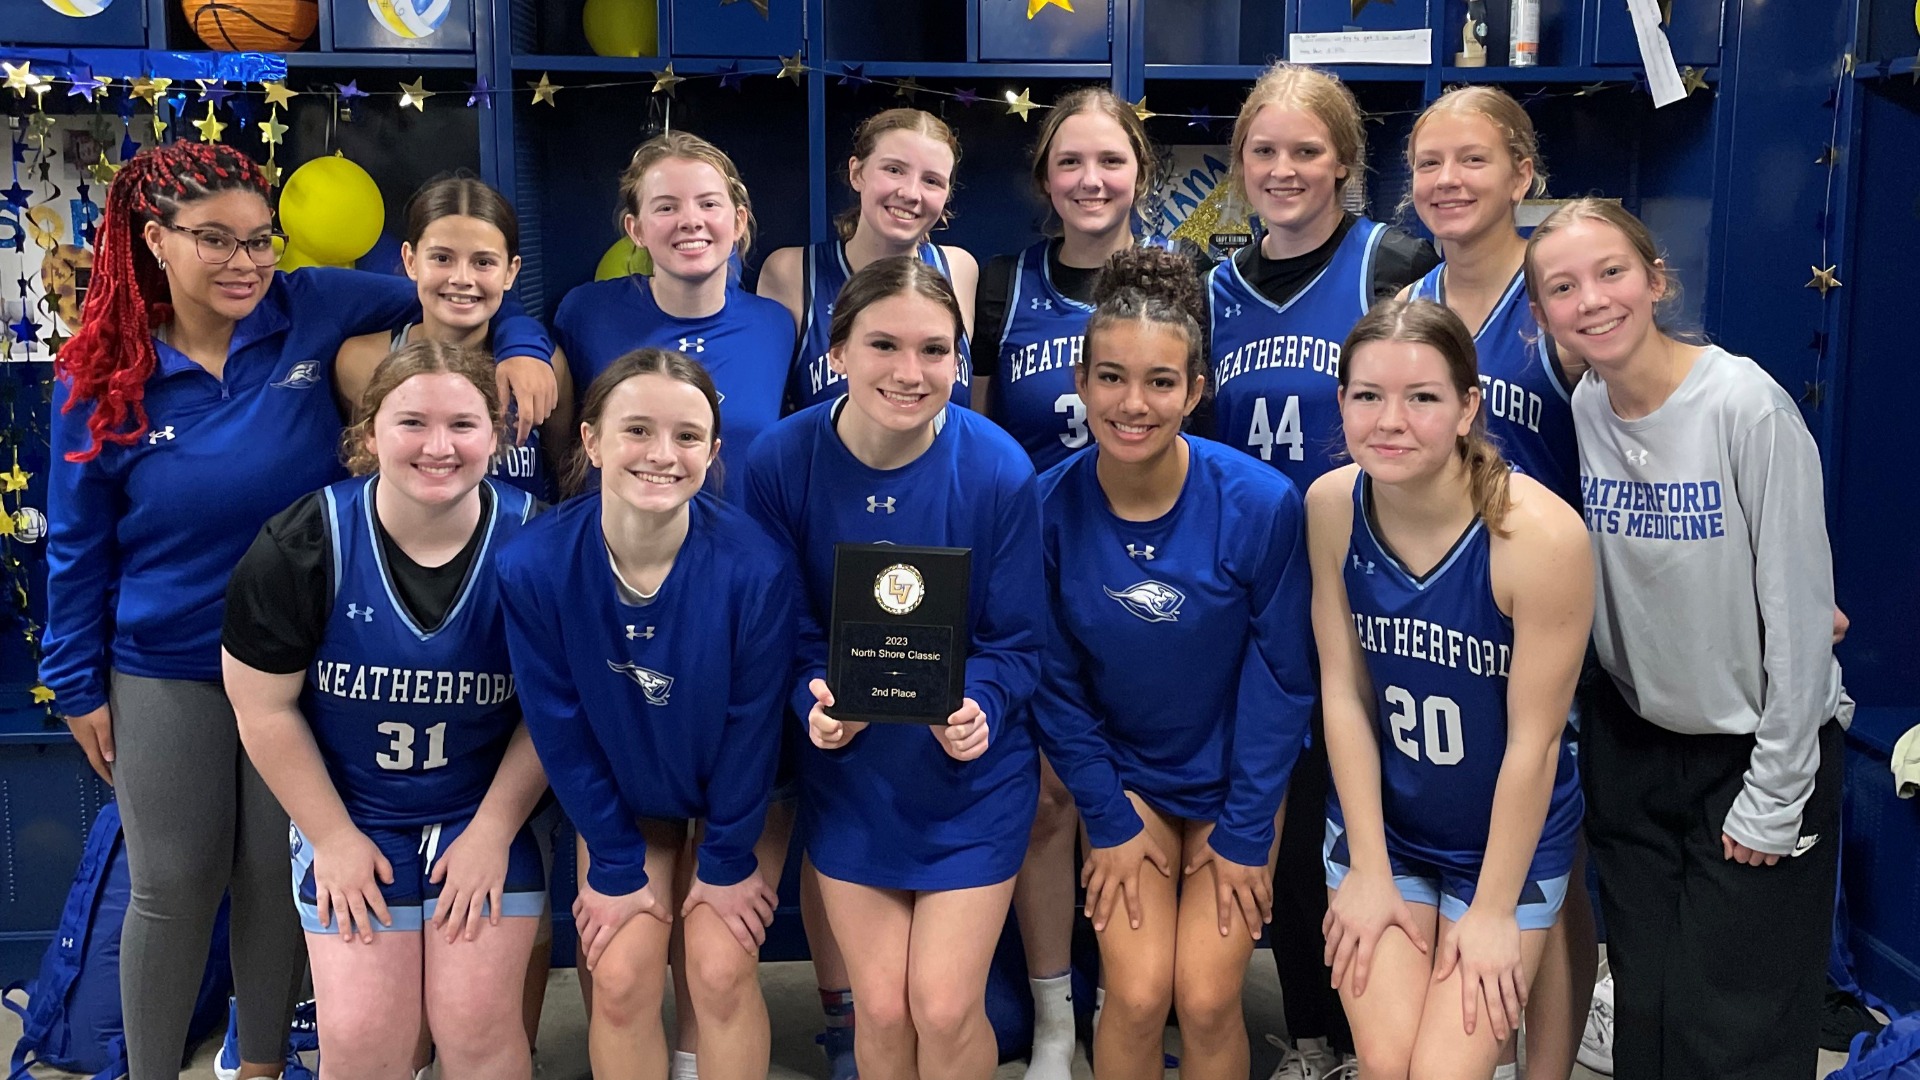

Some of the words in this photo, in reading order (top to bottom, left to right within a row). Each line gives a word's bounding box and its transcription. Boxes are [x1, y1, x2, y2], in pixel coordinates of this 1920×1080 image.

[1054, 393, 1089, 449] 3
[1247, 395, 1304, 461] 44
[1581, 476, 1722, 513] EATHERFORD
[1625, 512, 1725, 541] MEDICINE
[888, 574, 913, 605] LV
[851, 647, 876, 659] North
[878, 648, 906, 660] Shore
[907, 650, 941, 661] Classic
[884, 636, 909, 647] 2023
[1351, 612, 1512, 678] EATHERFORD
[871, 686, 889, 698] 2nd
[891, 687, 917, 699] Place
[1384, 684, 1465, 766] 20
[375, 721, 449, 771] 31
